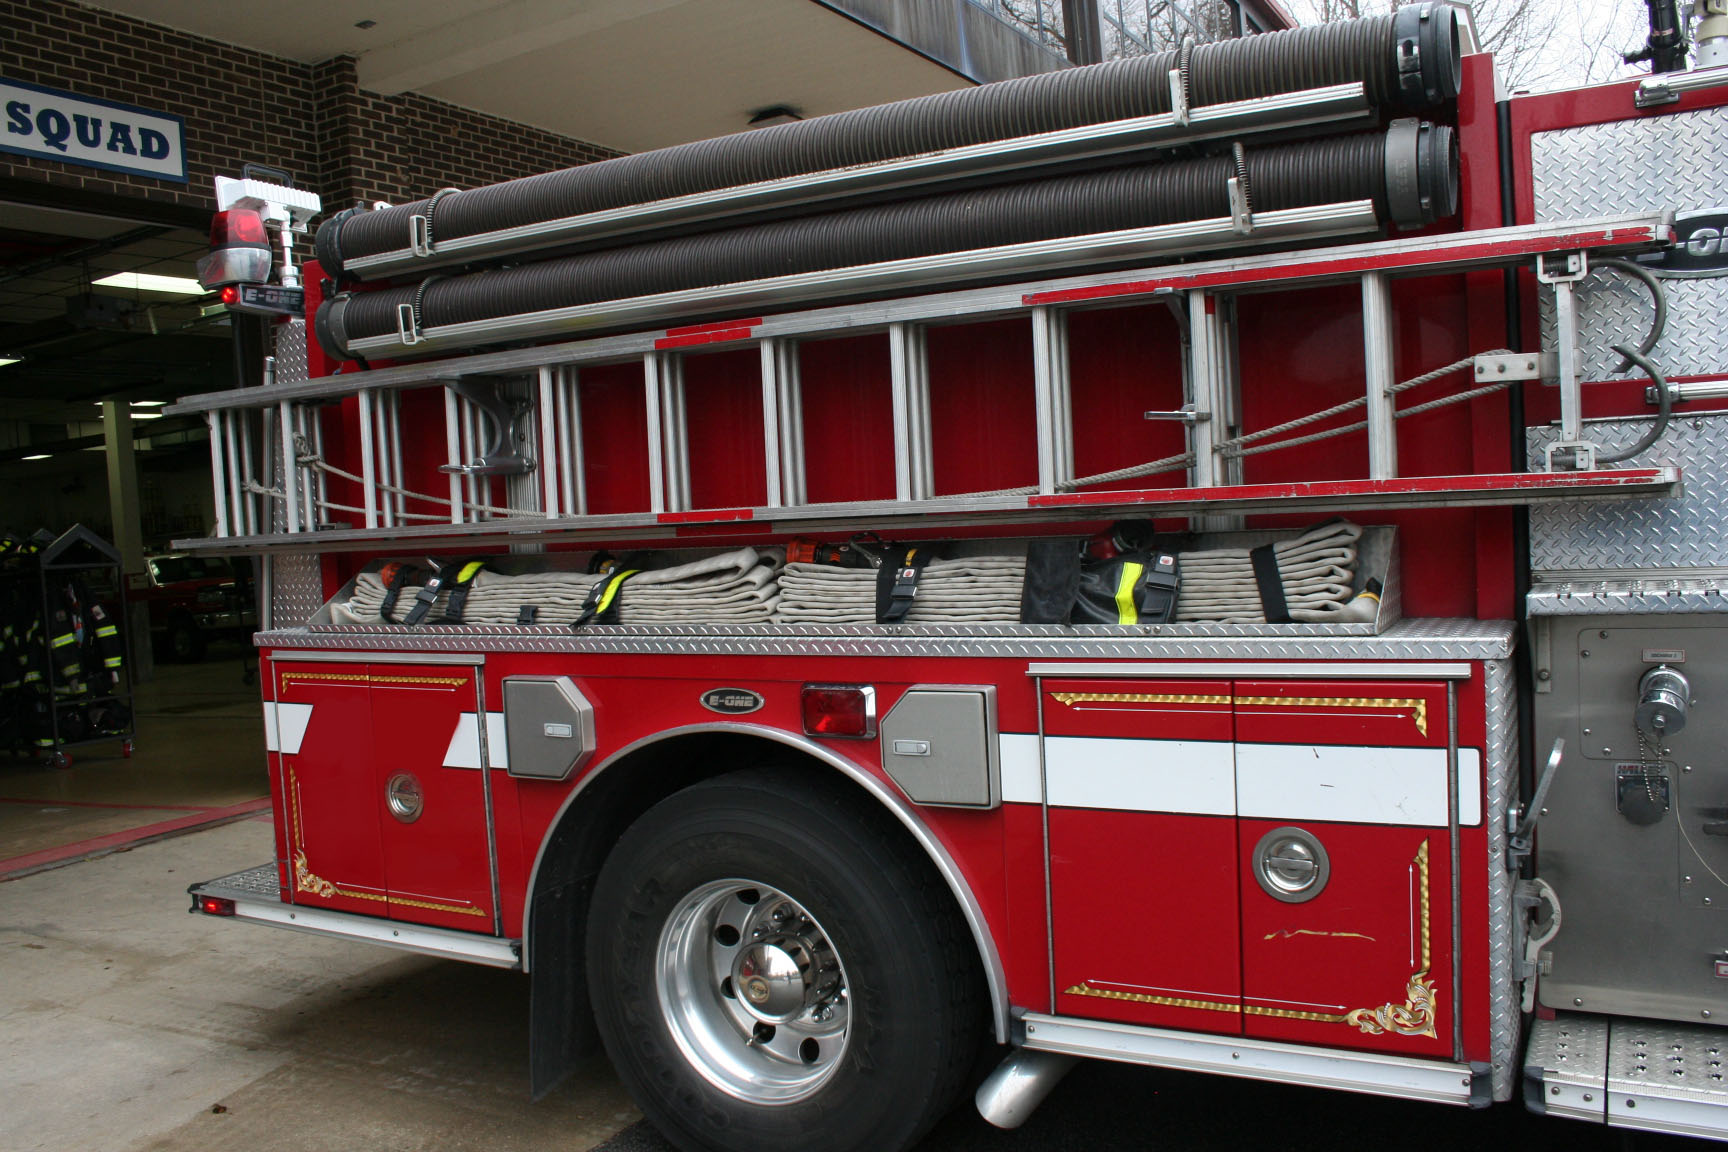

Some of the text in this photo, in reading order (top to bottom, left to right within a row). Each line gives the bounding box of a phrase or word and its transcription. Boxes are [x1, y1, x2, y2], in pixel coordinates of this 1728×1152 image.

[6, 100, 170, 160] SQUAD
[245, 288, 302, 305] E-ONE
[709, 695, 754, 707] E-ONE
